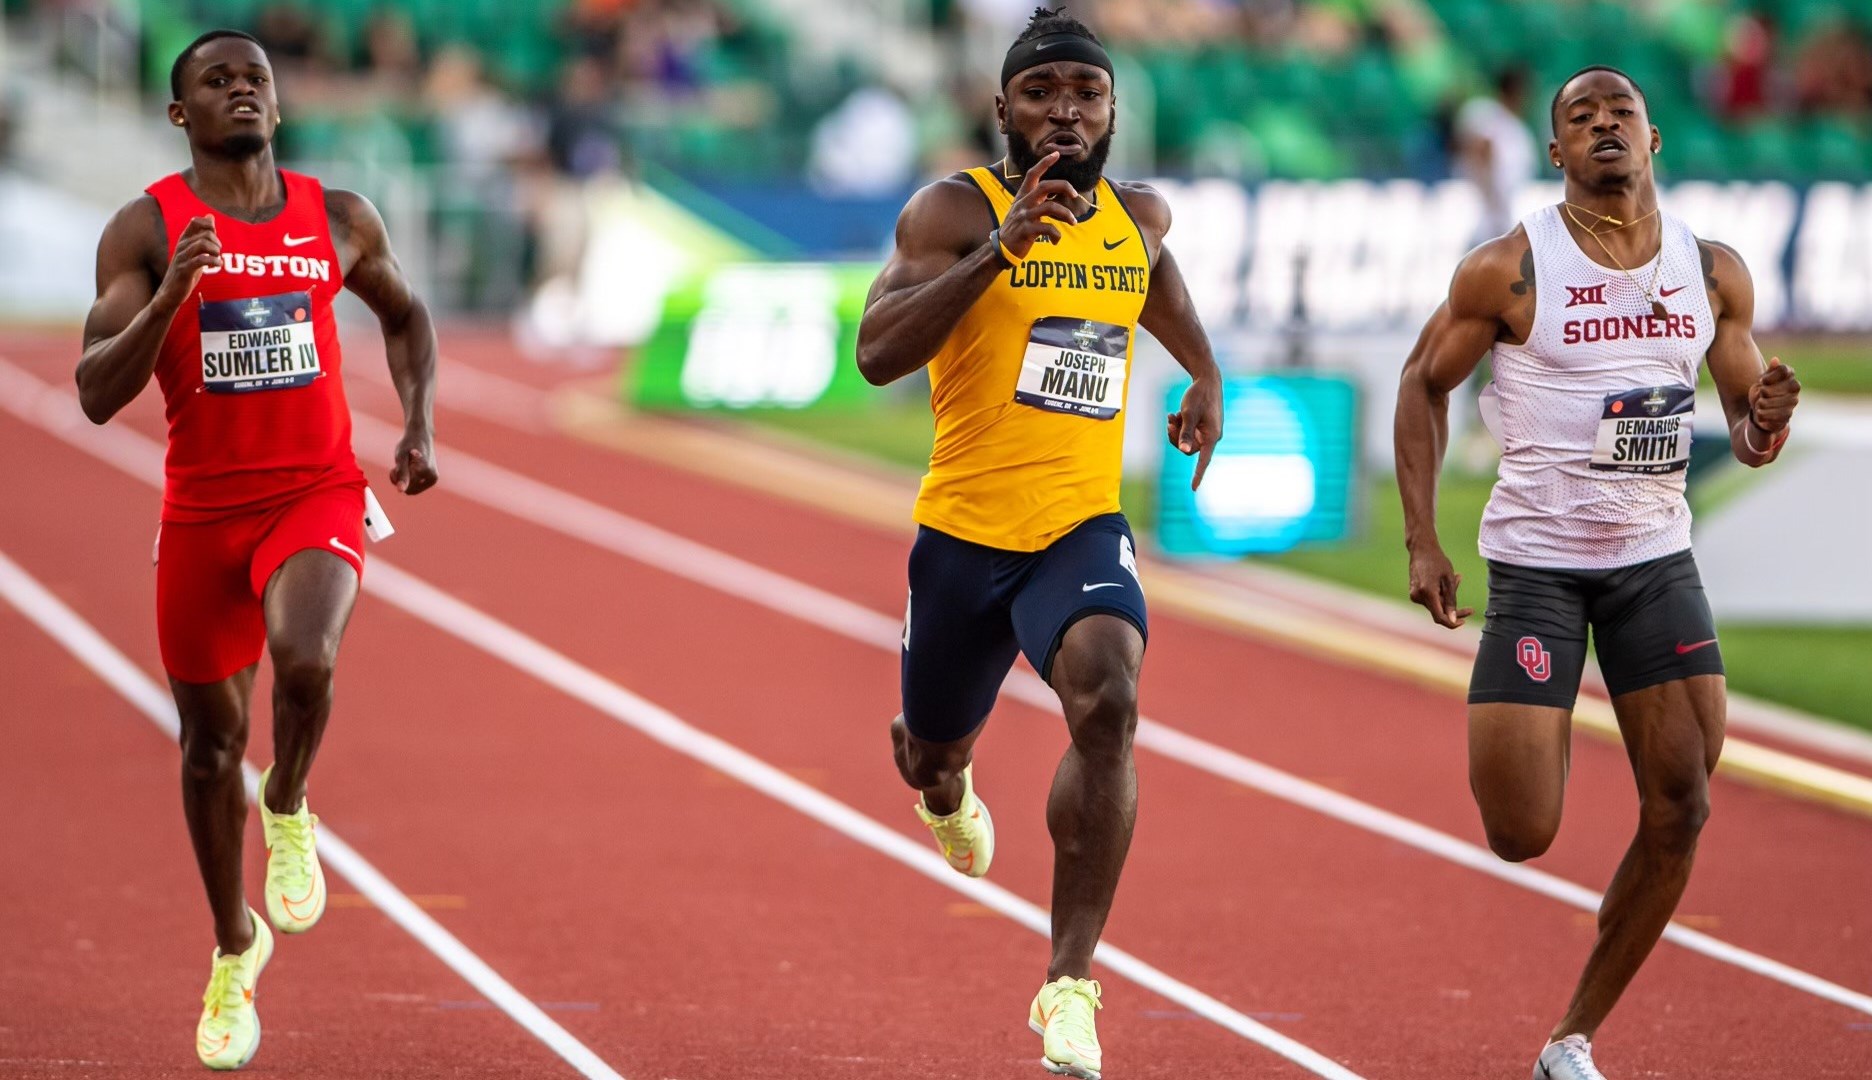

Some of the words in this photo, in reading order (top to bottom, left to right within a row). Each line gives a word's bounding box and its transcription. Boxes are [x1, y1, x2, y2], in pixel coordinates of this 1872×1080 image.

[202, 252, 330, 282] USTON
[1009, 260, 1088, 289] COPPIN
[1092, 265, 1146, 294] STATE
[1565, 283, 1607, 308] XII
[228, 328, 291, 349] EDWARD
[1563, 313, 1696, 344] SOONERS
[204, 347, 294, 378] SUMLER
[298, 343, 316, 369] IV
[1054, 350, 1106, 374] JOSEPH
[1040, 366, 1109, 403] MANU
[1616, 417, 1680, 435] DEMARIUS
[1612, 434, 1678, 461] SMITH
